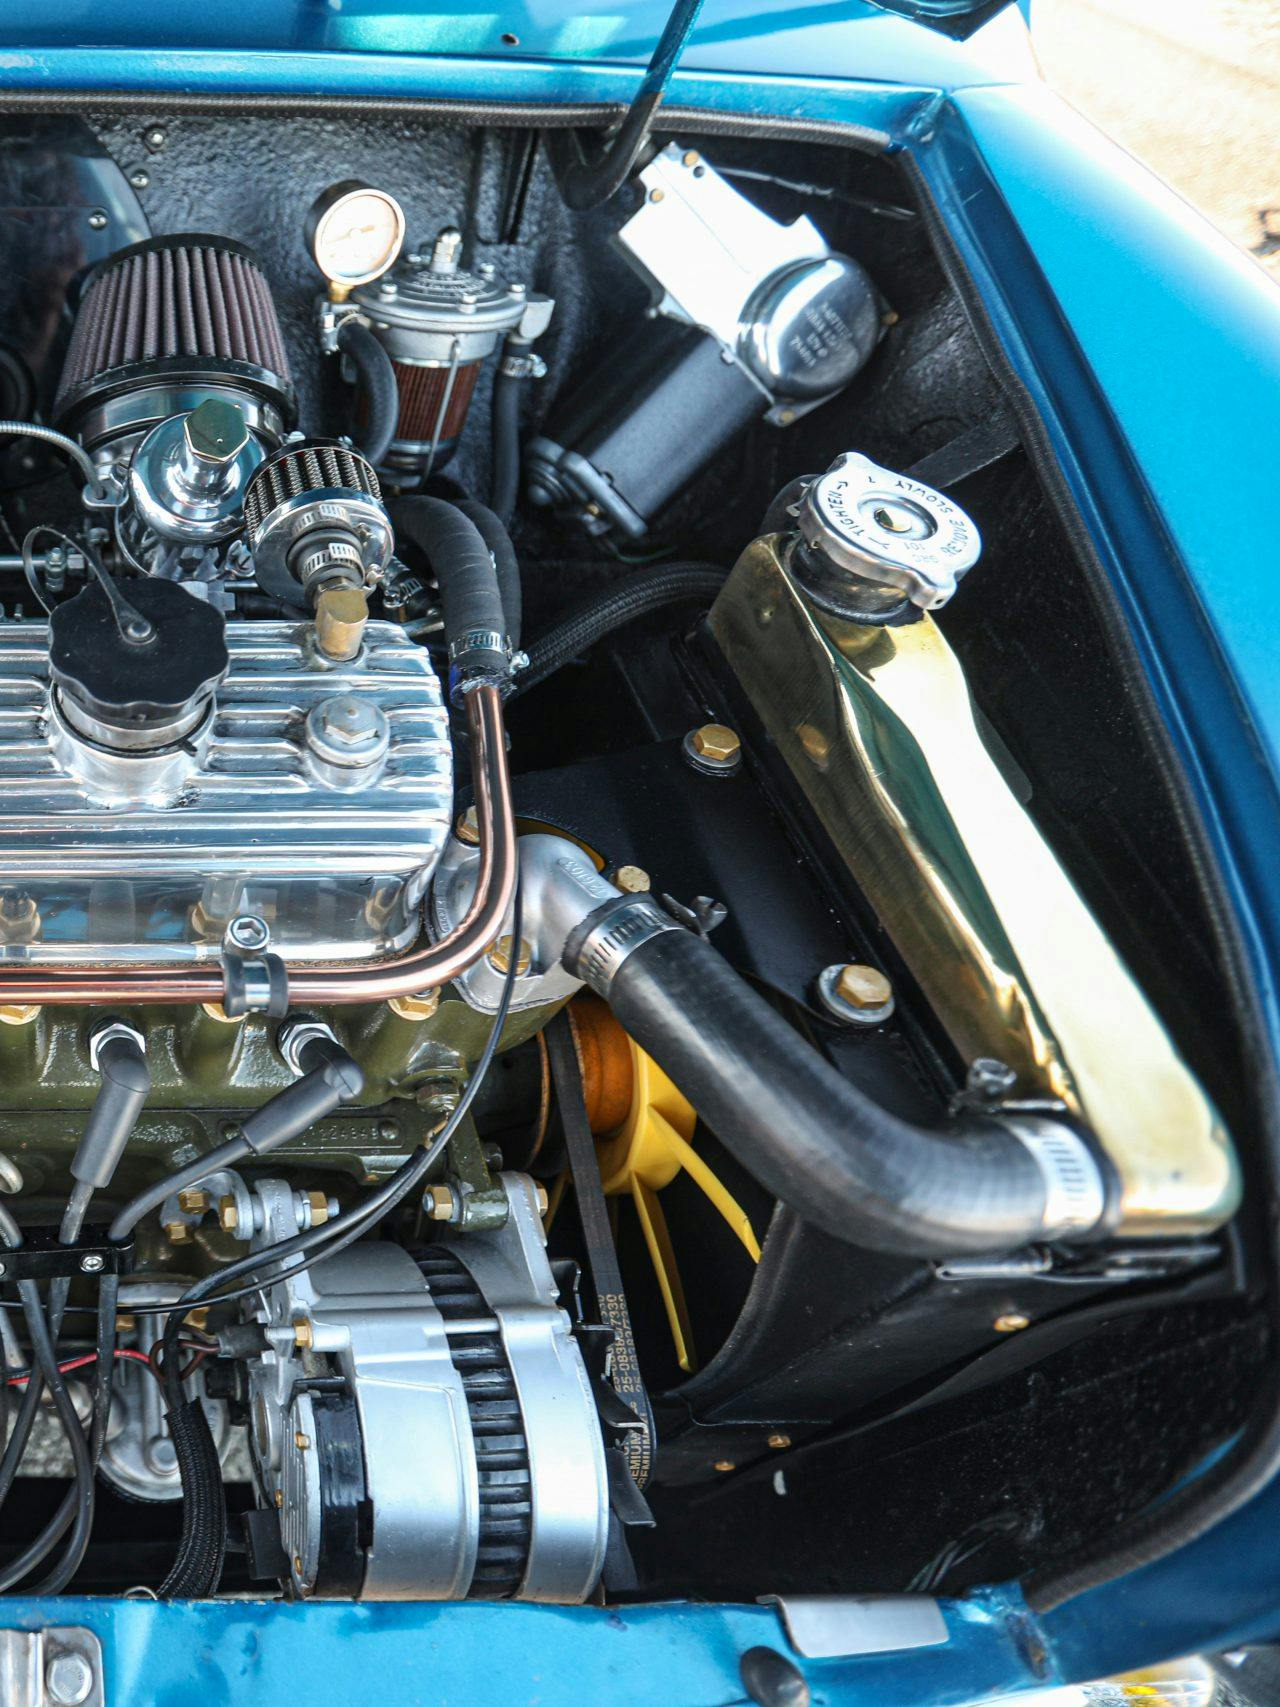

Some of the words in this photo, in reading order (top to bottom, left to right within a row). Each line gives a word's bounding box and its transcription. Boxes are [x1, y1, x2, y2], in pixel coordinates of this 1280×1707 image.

[827, 490, 865, 537] TIGHTEN
[895, 480, 954, 514] SLOWLY
[940, 519, 969, 556] REMOVE
